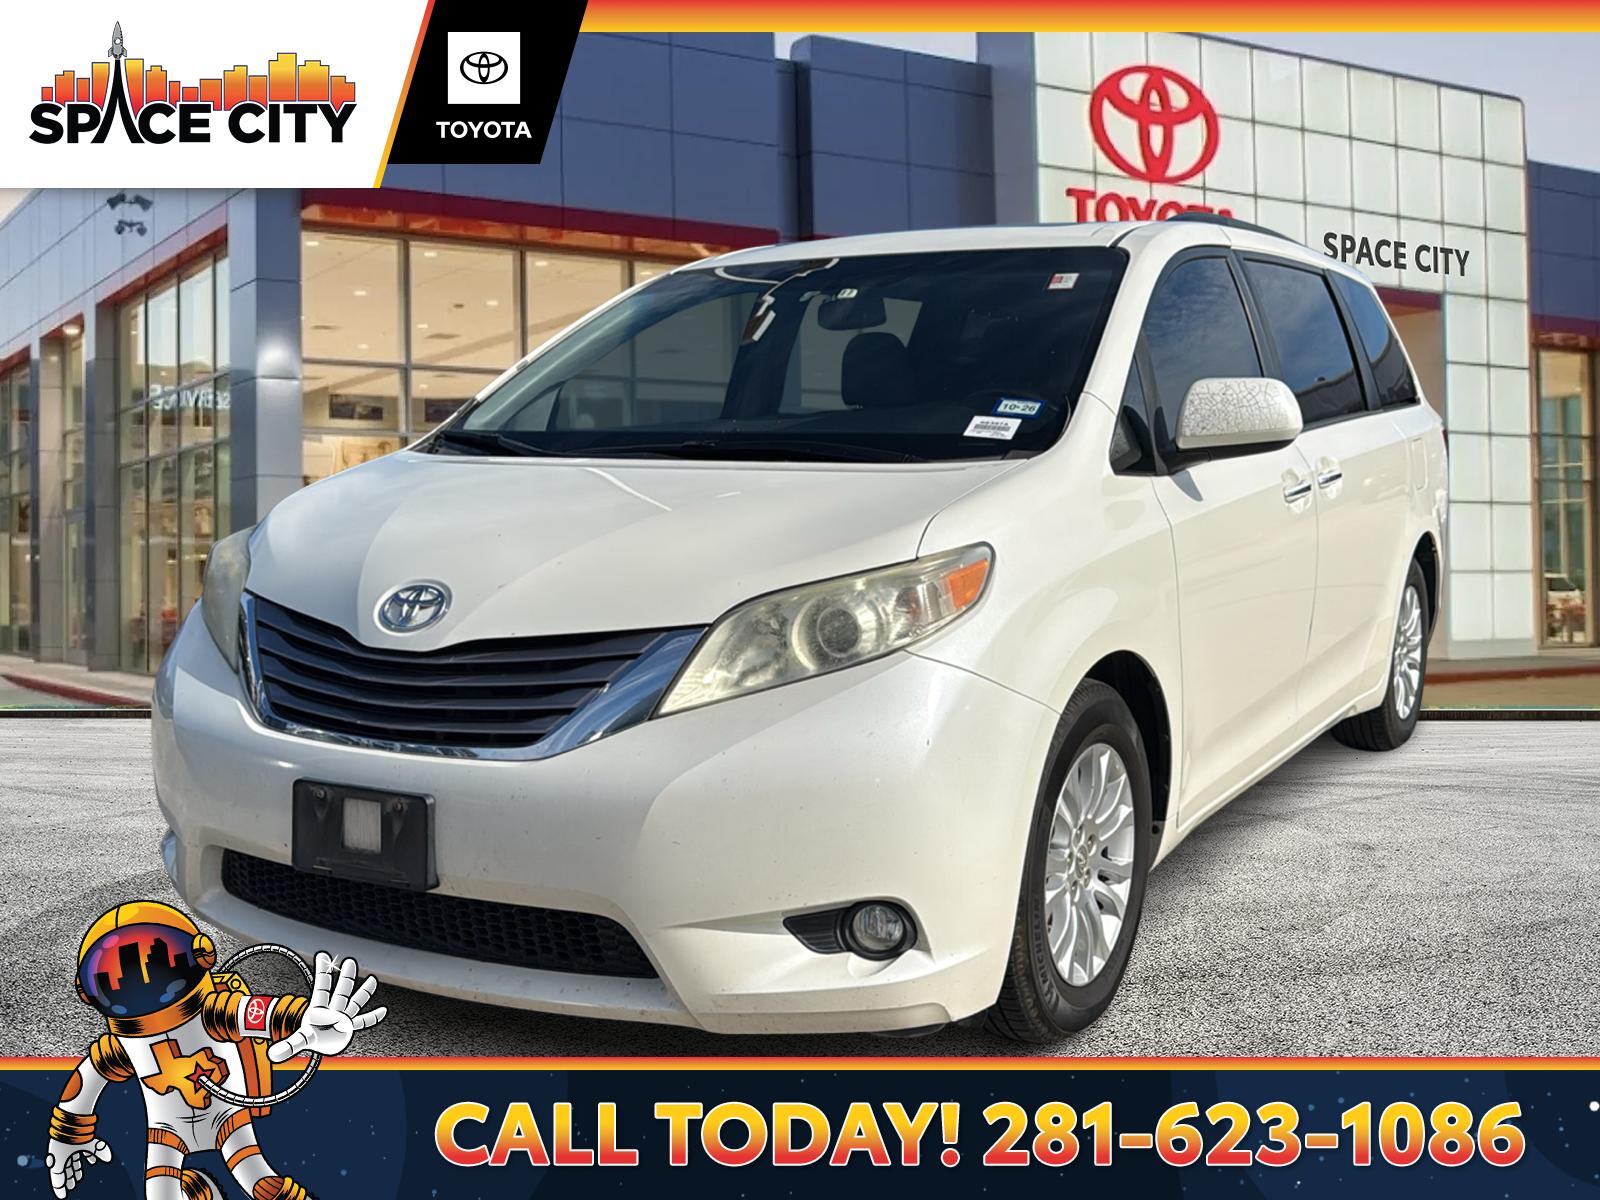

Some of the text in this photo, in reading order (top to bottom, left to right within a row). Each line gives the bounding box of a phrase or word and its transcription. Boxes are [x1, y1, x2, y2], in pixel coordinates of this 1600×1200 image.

[1066, 188, 1233, 223] TOY
[1323, 232, 1470, 277] SPACE CITY
